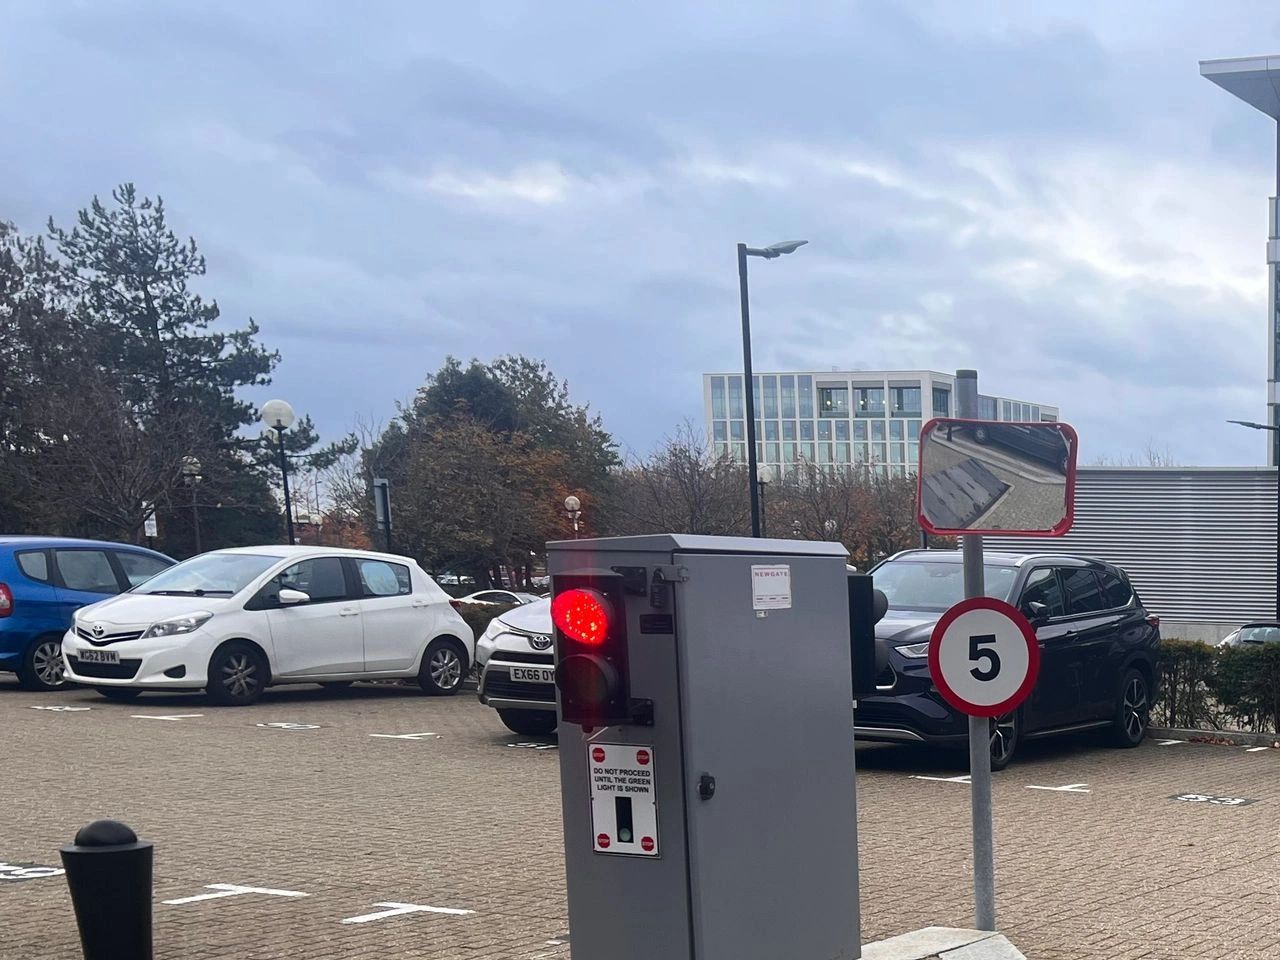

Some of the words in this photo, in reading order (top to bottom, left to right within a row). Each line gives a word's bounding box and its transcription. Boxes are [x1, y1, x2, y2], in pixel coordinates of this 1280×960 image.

[969, 634, 1000, 681] 5
[514, 668, 540, 680] EX66
[619, 769, 651, 777] PROCEED
